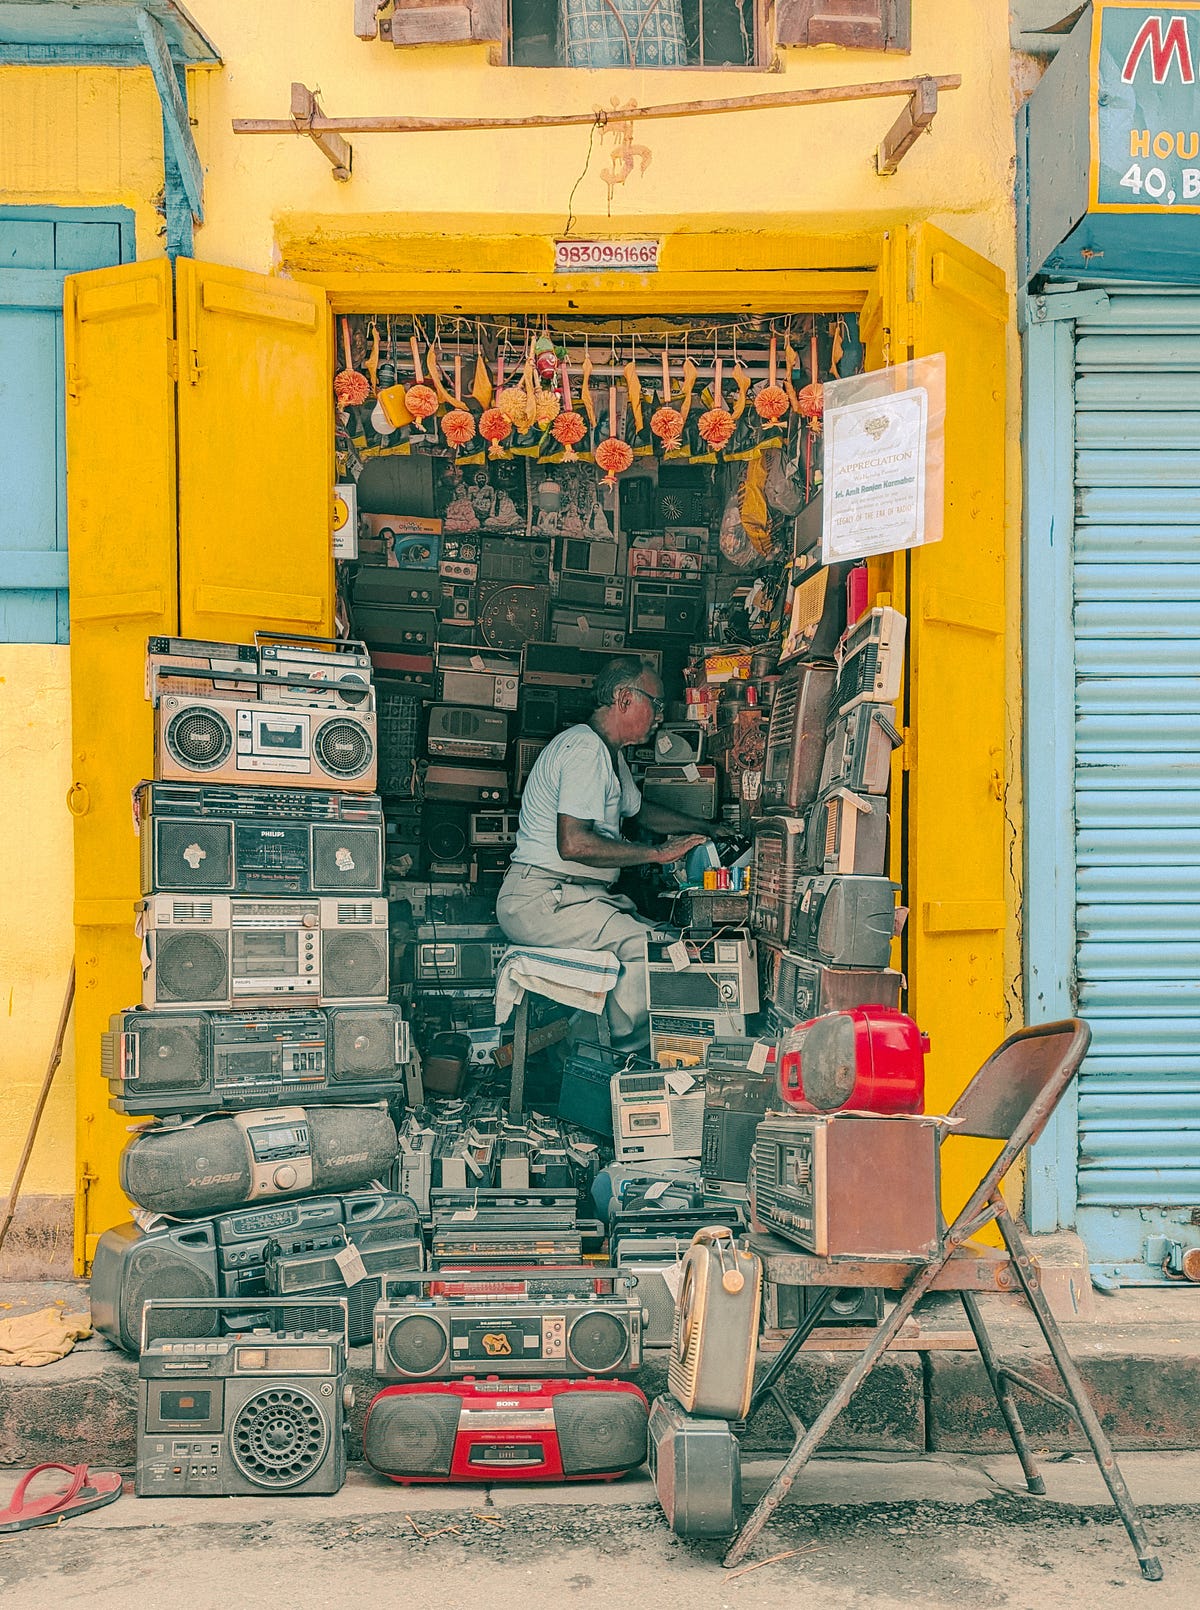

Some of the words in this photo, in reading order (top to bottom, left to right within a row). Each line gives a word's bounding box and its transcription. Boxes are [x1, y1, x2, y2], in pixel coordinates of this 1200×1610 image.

[1121, 16, 1200, 84] M
[1120, 163, 1176, 205] 40,
[559, 246, 657, 262] 9830961668
[839, 450, 913, 474] APPRECIATION
[845, 487, 860, 497] Amit
[861, 482, 882, 493] Ranjan
[865, 512, 873, 520] THE
